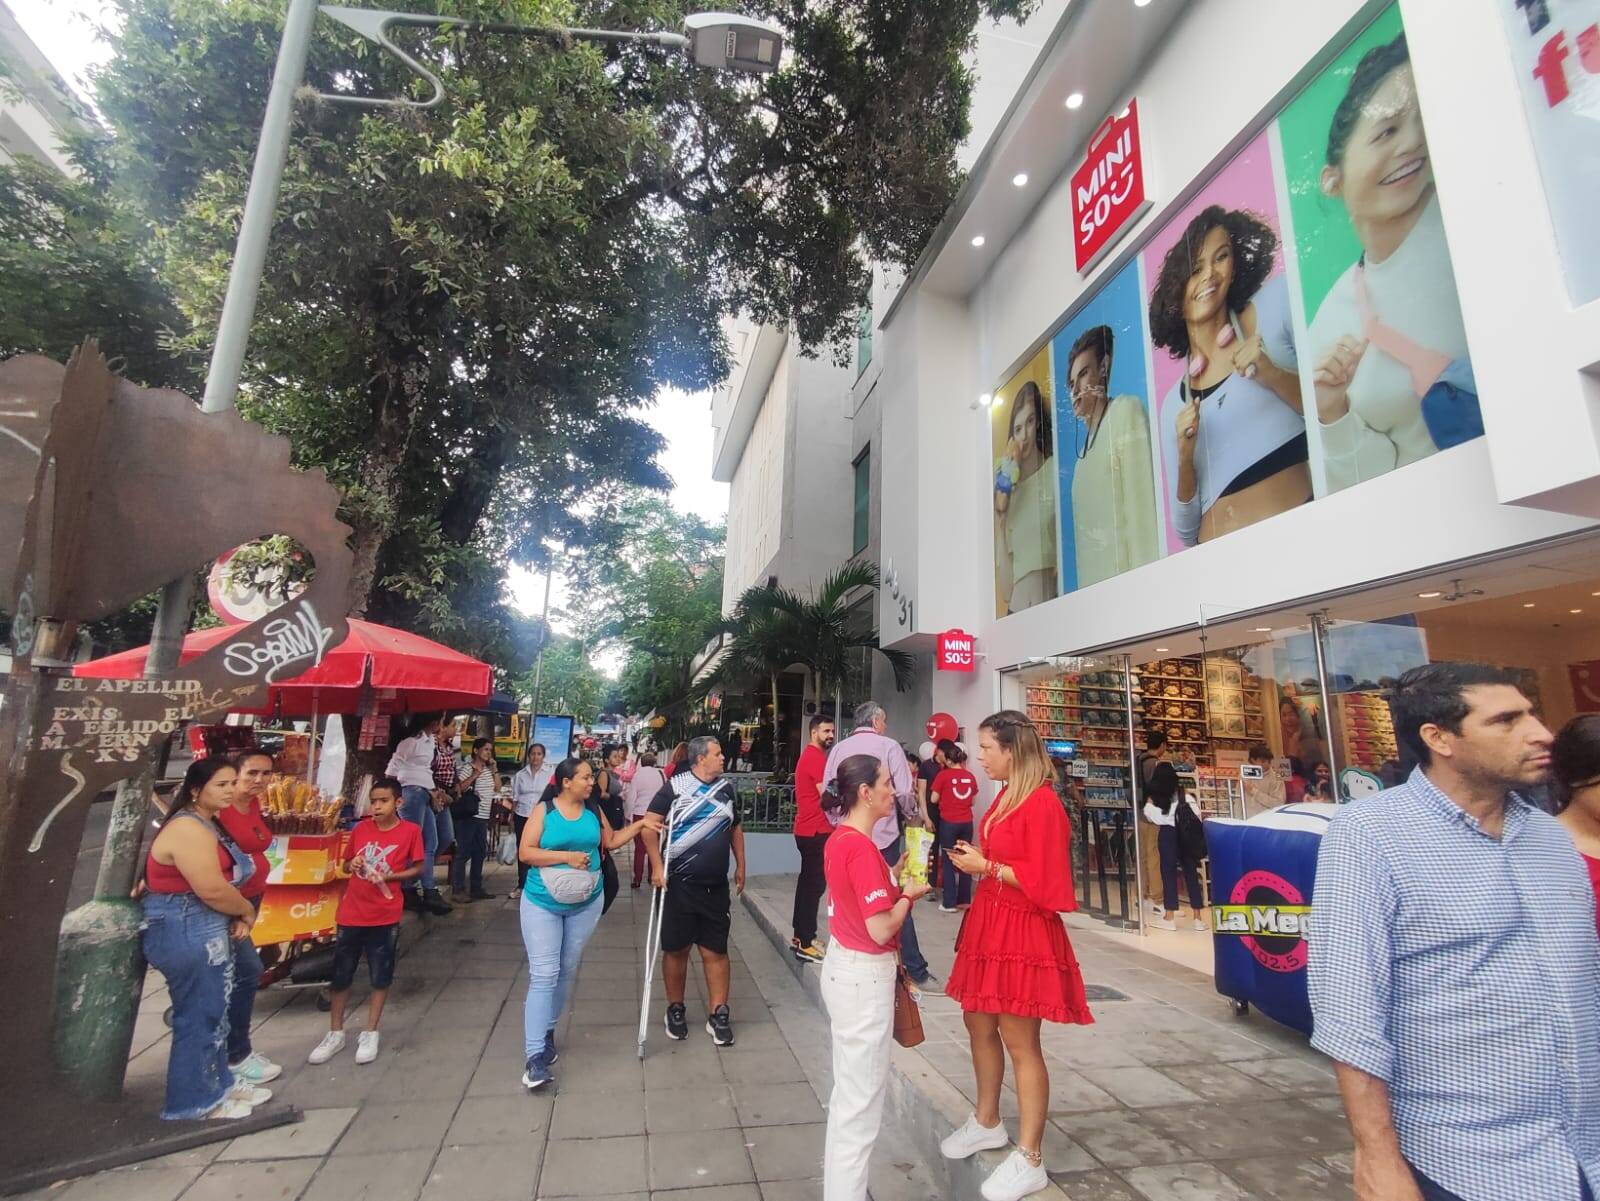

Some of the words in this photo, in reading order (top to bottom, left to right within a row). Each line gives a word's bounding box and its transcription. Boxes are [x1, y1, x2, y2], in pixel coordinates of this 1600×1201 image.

[1077, 127, 1132, 214] MINI
[944, 639, 971, 652] MINI
[55, 677, 89, 692] EL
[164, 706, 194, 721] EL
[1215, 907, 1249, 932] La
